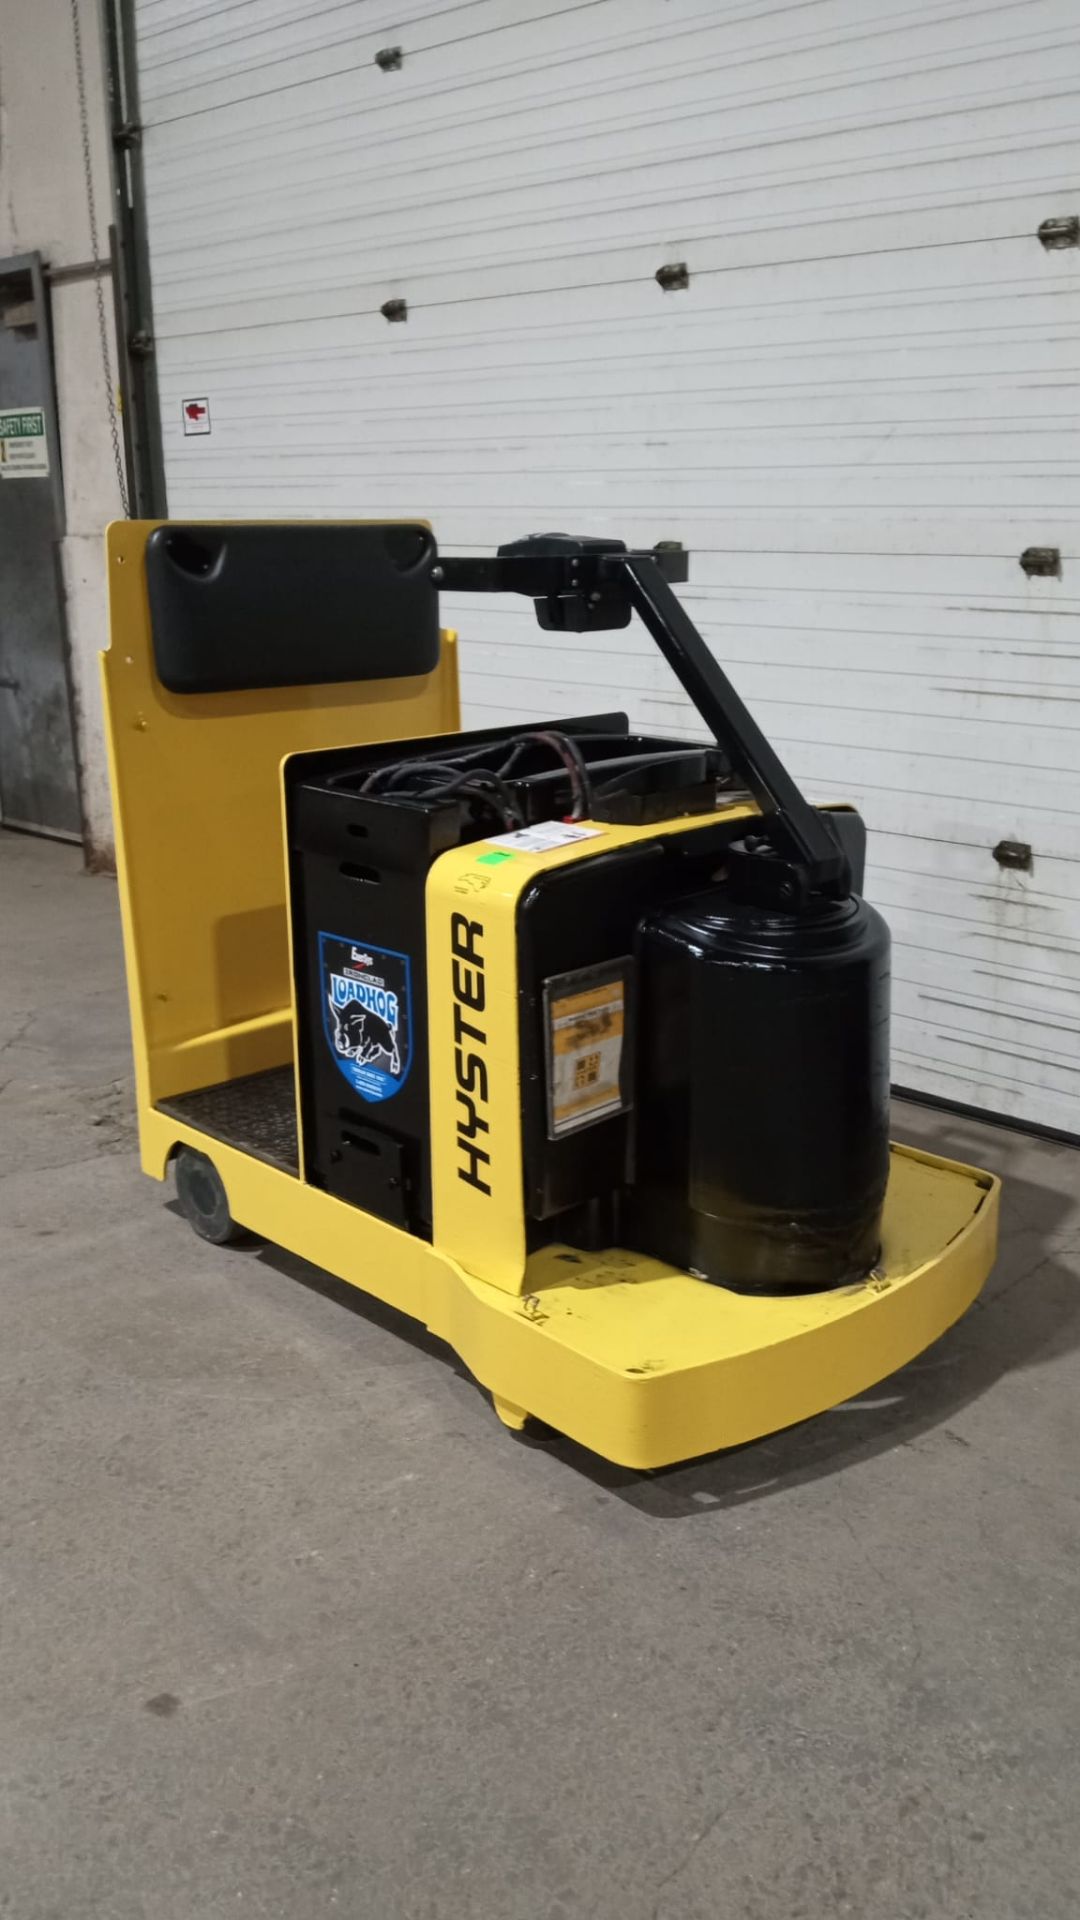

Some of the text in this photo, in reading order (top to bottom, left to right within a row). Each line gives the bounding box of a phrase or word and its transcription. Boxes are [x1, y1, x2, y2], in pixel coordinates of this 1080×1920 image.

[22, 415, 42, 435] FIRST
[344, 968, 384, 986] IRONCLAD
[331, 976, 397, 1029] LOADHOG
[451, 911, 492, 1197] HYSTER
